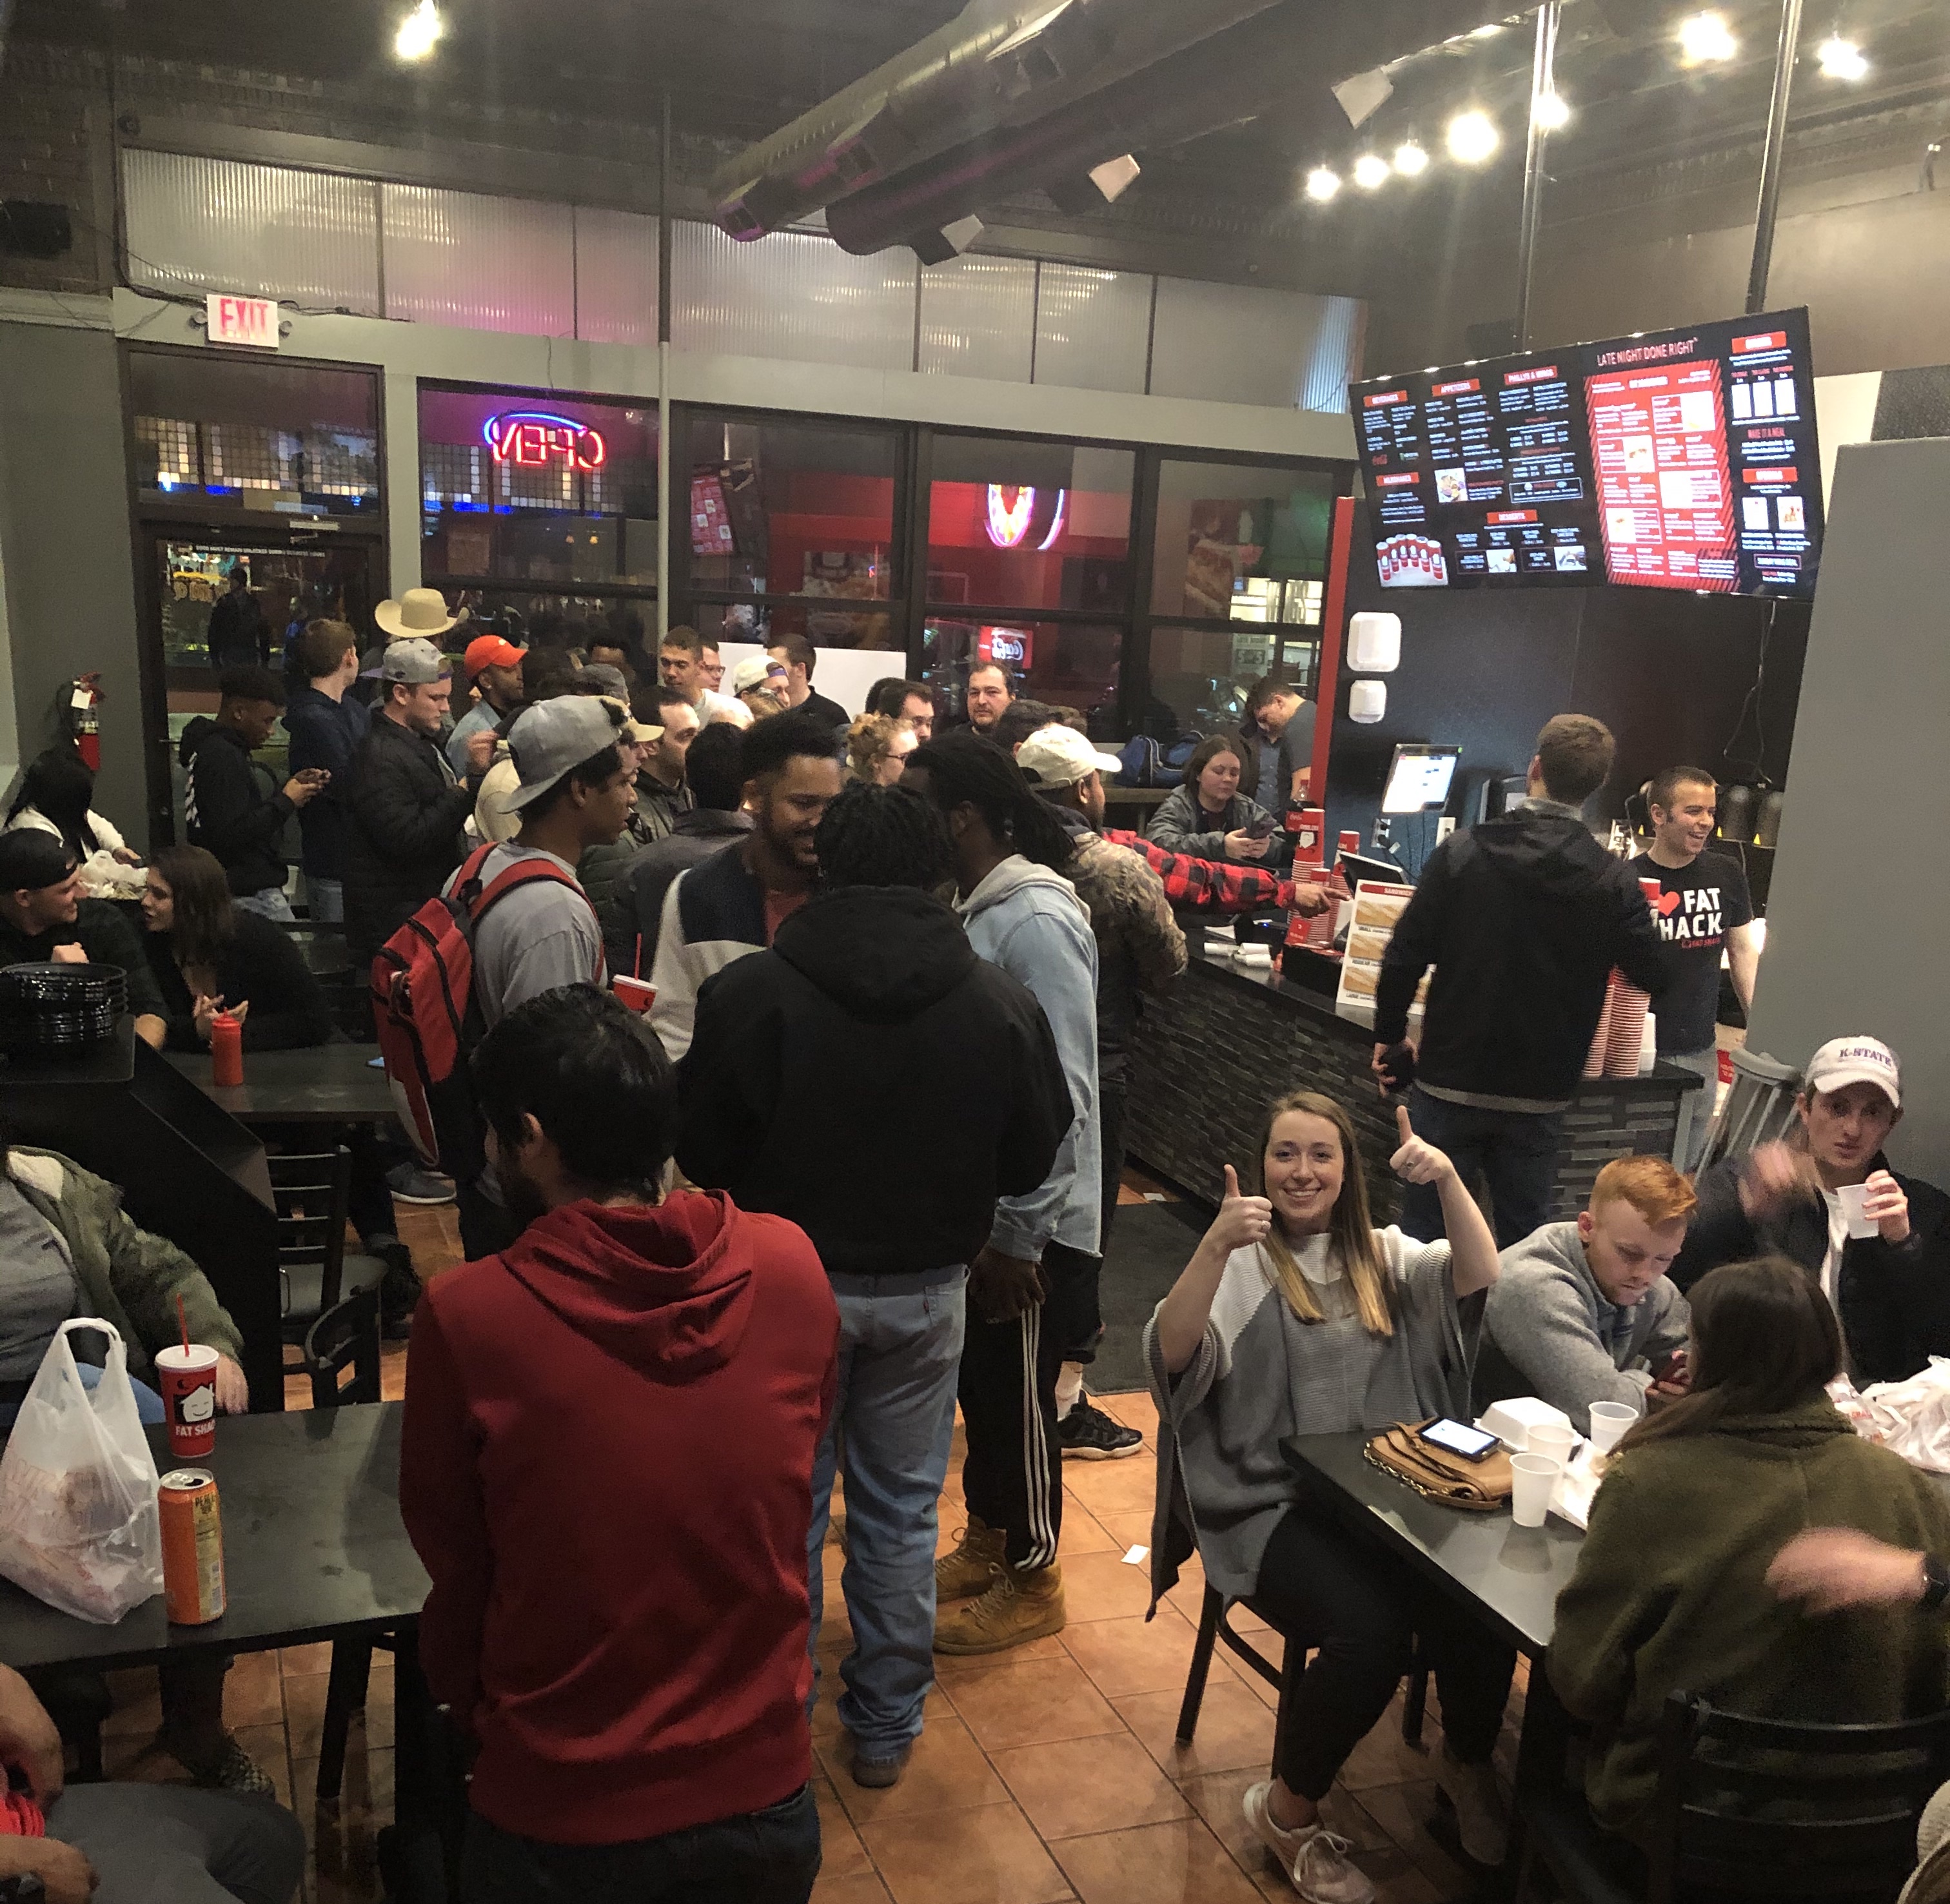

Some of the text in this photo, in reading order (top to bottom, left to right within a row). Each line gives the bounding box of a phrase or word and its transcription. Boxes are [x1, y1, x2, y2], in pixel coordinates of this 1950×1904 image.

[220, 299, 268, 339] EXIT
[1597, 340, 1694, 366] LATE NIGHT DONE RIGHT
[1684, 888, 1720, 913] FAT
[1659, 912, 1722, 941] HACK
[1840, 1046, 1893, 1067] K-STATE
[175, 1418, 215, 1437] FAT SHAC
